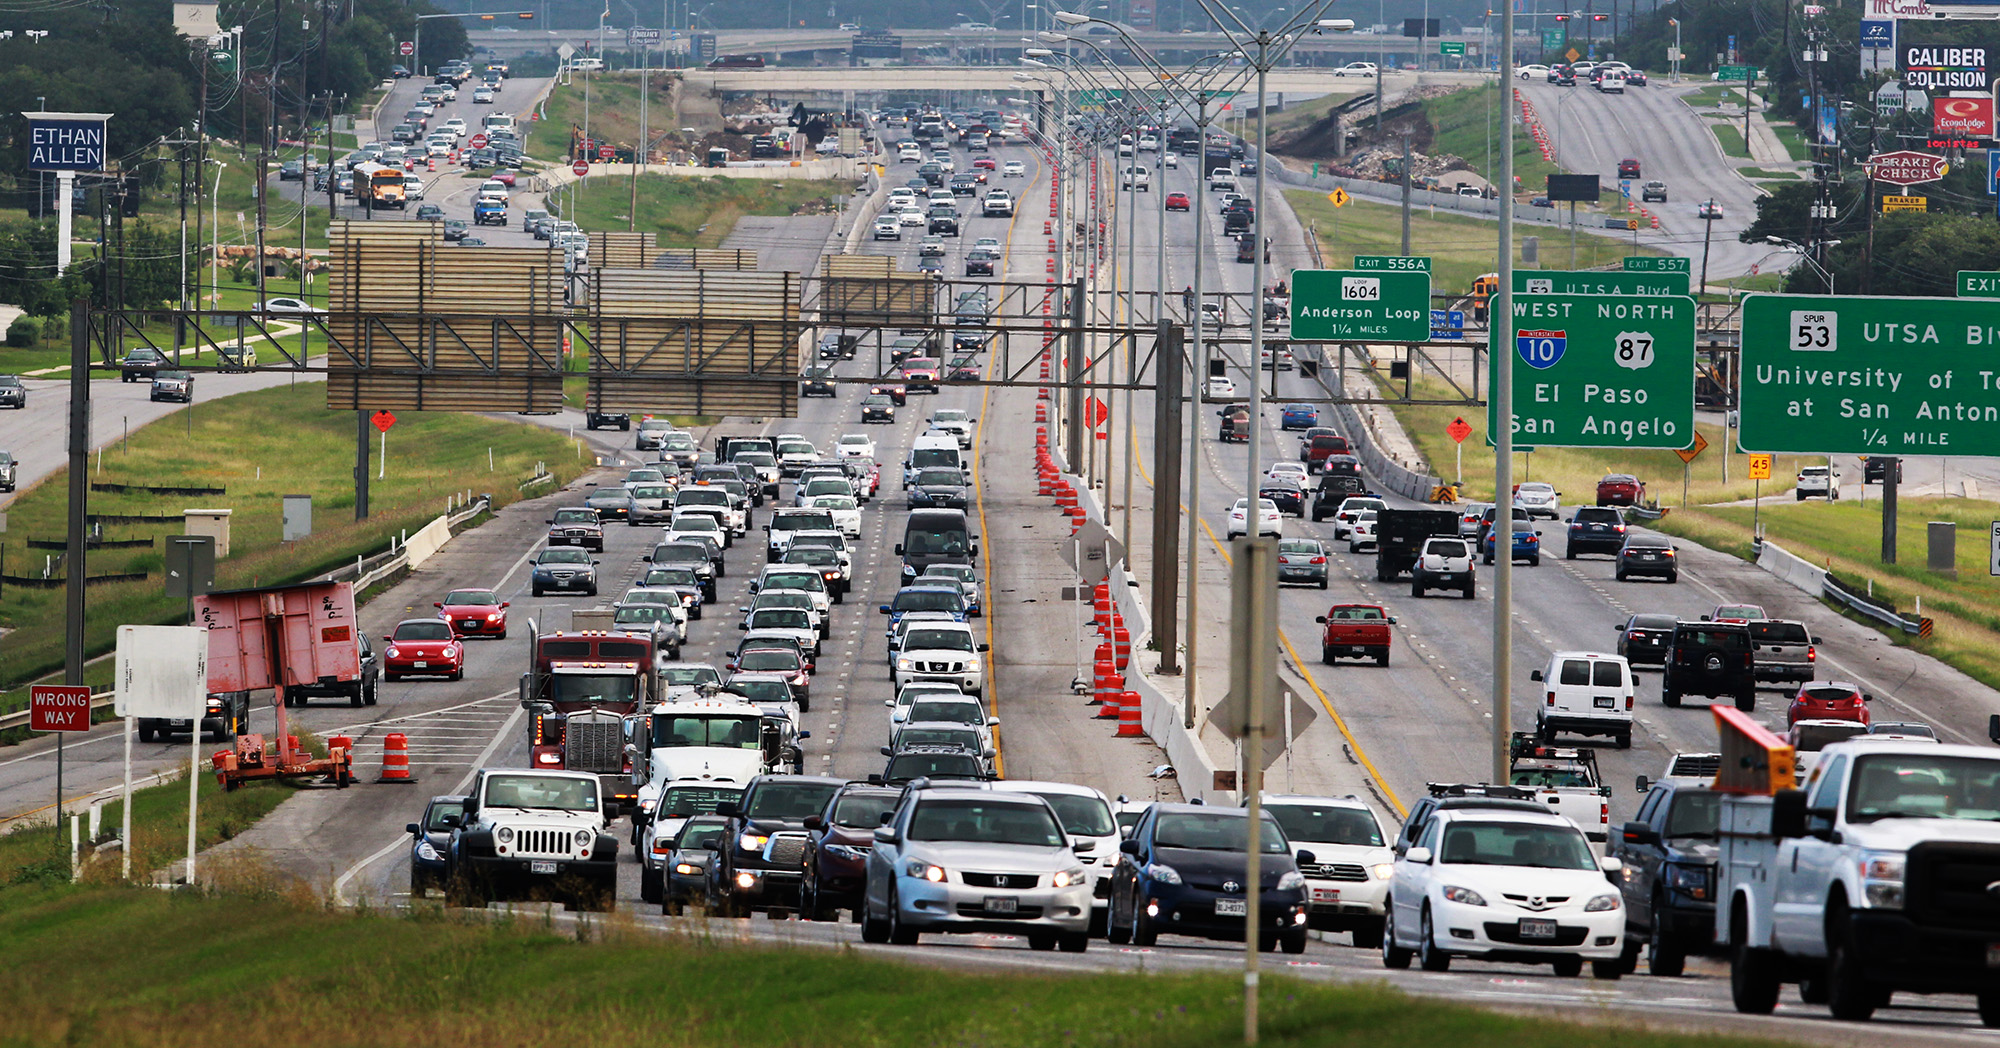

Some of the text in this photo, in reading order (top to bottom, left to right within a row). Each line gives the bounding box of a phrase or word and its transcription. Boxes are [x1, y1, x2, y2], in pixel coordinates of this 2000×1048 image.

[1907, 48, 1986, 67] CALIBER
[1907, 71, 1986, 88] COLLISION
[1878, 97, 1902, 106] MINI
[32, 128, 100, 145] ETHAN
[32, 147, 100, 164] ALLEN
[1881, 157, 1930, 168] BRAKE
[1880, 168, 1931, 179] CHECK
[1359, 258, 1426, 270] EXIT 556A
[1628, 259, 1686, 270] EXIT 557
[1344, 286, 1378, 298] 1604
[1566, 284, 1670, 296] UTSA Blvd
[1300, 306, 1421, 321] Anderson Loop
[1513, 302, 1674, 319] WEST NORTH
[1803, 314, 1825, 323] SPUR
[1359, 326, 1388, 334] MILES
[1798, 325, 1830, 347] 53
[1863, 322, 1940, 344] UTSA
[1528, 339, 1555, 361] 10
[1619, 339, 1652, 361] 87
[1756, 364, 1903, 392] University
[1928, 370, 1953, 389] of
[1535, 383, 1648, 404] El Paso
[1787, 398, 1998, 422] at San Anton
[1512, 414, 1676, 441] San Angelo
[1903, 431, 1949, 446] MILE
[1752, 459, 1768, 470] 45
[34, 692, 87, 707] WRONG
[44, 711, 76, 725] WAY
